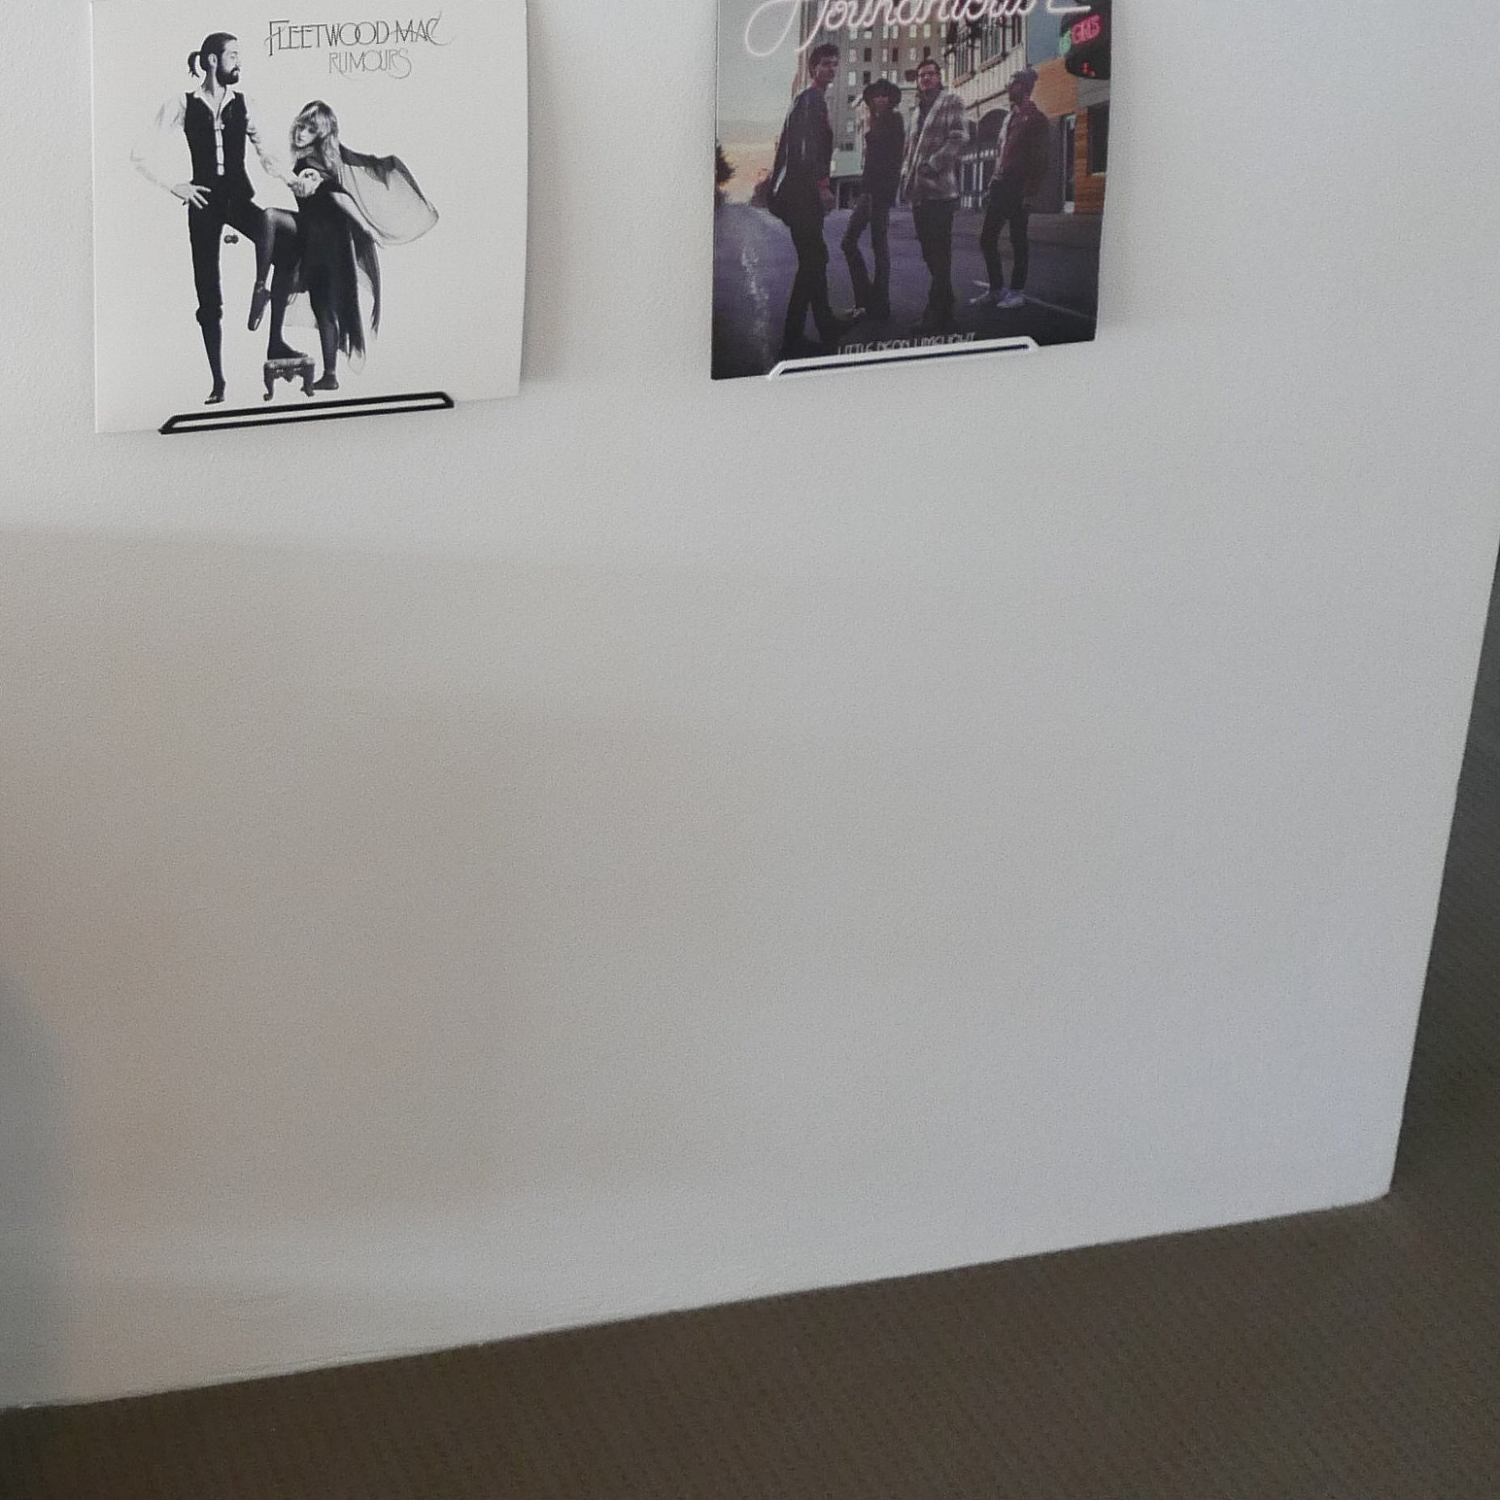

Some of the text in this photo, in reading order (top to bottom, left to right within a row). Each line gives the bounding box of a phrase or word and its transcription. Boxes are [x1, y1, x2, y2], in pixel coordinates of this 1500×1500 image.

[264, 11, 453, 57] FLEETWOOD MAC
[328, 48, 413, 80] RUMOURS
